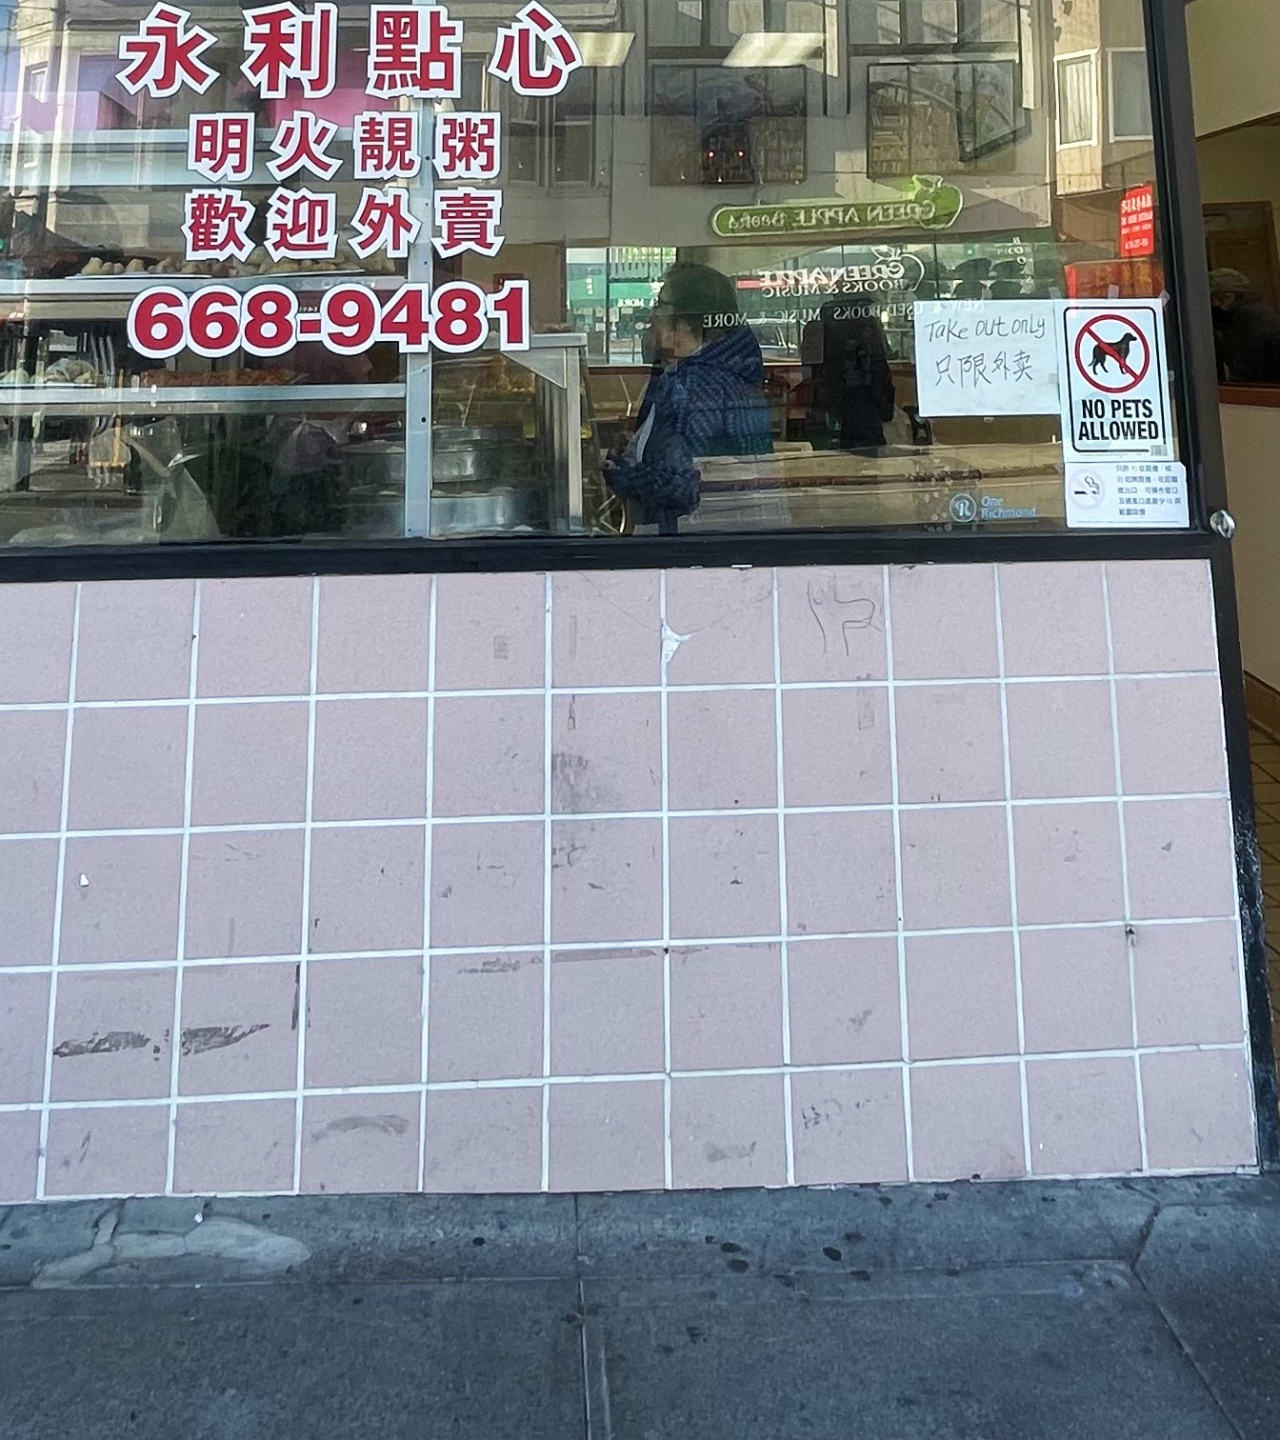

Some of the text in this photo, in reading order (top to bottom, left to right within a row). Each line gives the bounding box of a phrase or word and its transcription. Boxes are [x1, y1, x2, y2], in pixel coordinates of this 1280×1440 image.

[115, 0, 584, 101] 永利點心
[187, 111, 501, 182] 明火靚粥
[180, 187, 505, 261] 歡迎外賣
[126, 279, 532, 358] 668-9481
[923, 317, 970, 343] Take
[1078, 420, 1160, 442] ALLOWED
[1081, 398, 1154, 420] NO PETS
[981, 505, 1037, 520] Richmond
